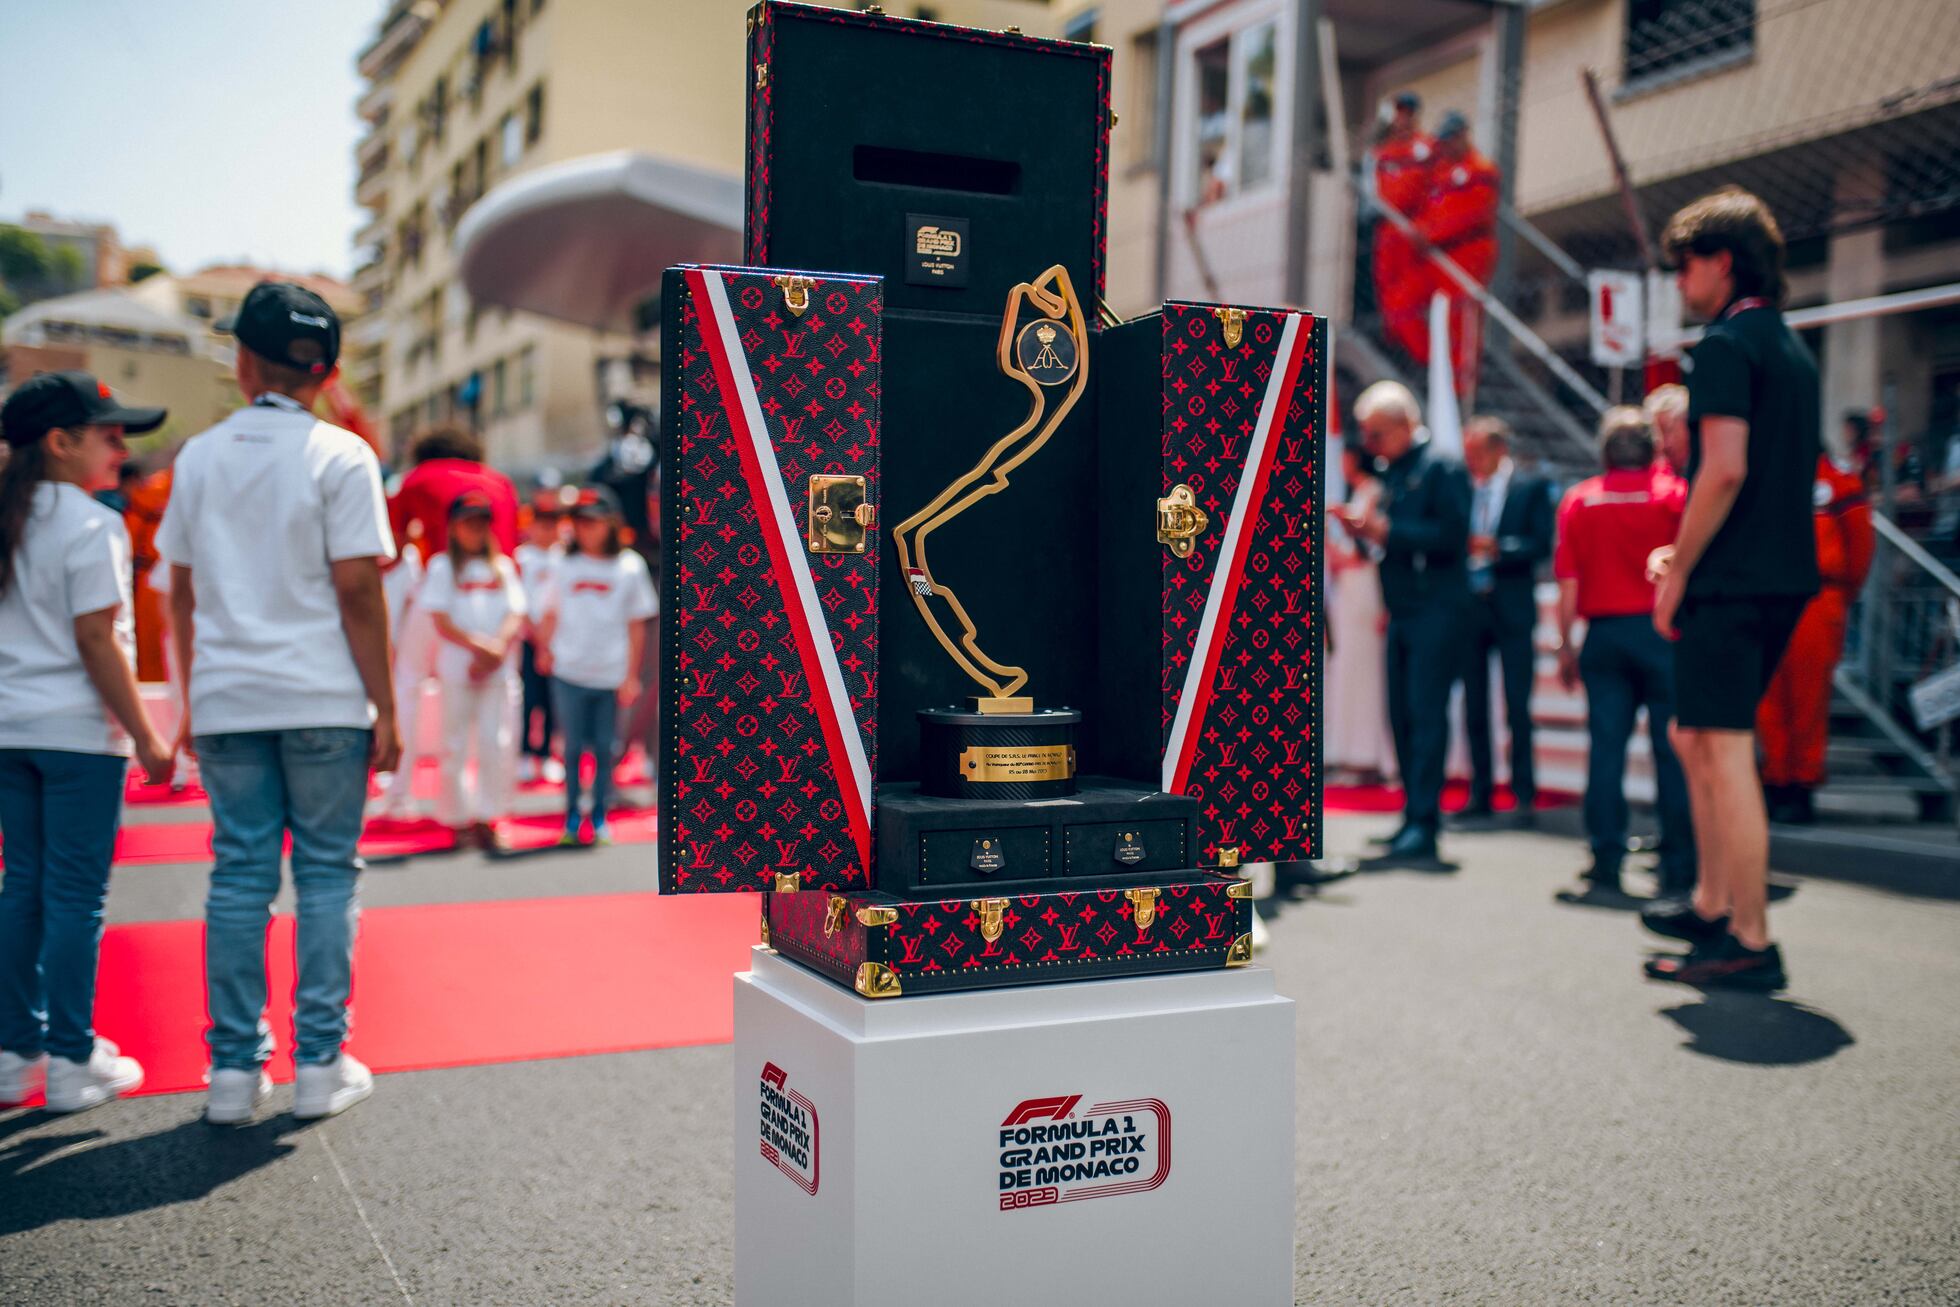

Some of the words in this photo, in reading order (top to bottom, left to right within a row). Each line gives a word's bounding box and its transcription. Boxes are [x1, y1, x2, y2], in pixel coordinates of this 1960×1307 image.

[760, 1080, 800, 1124] FORMULA
[760, 1100, 789, 1135] GRAND
[789, 1122, 810, 1153] PRIX
[1000, 1117, 1119, 1148] FORMULA
[1123, 1116, 1136, 1133] 1
[760, 1118, 771, 1142] DE
[771, 1128, 808, 1170] MONACO
[1000, 1142, 1086, 1168] GRAND
[1090, 1134, 1146, 1158] PRIX
[1000, 1169, 1032, 1190] DE
[1035, 1156, 1140, 1186] MONACO
[1000, 1188, 1058, 1210] 2023
